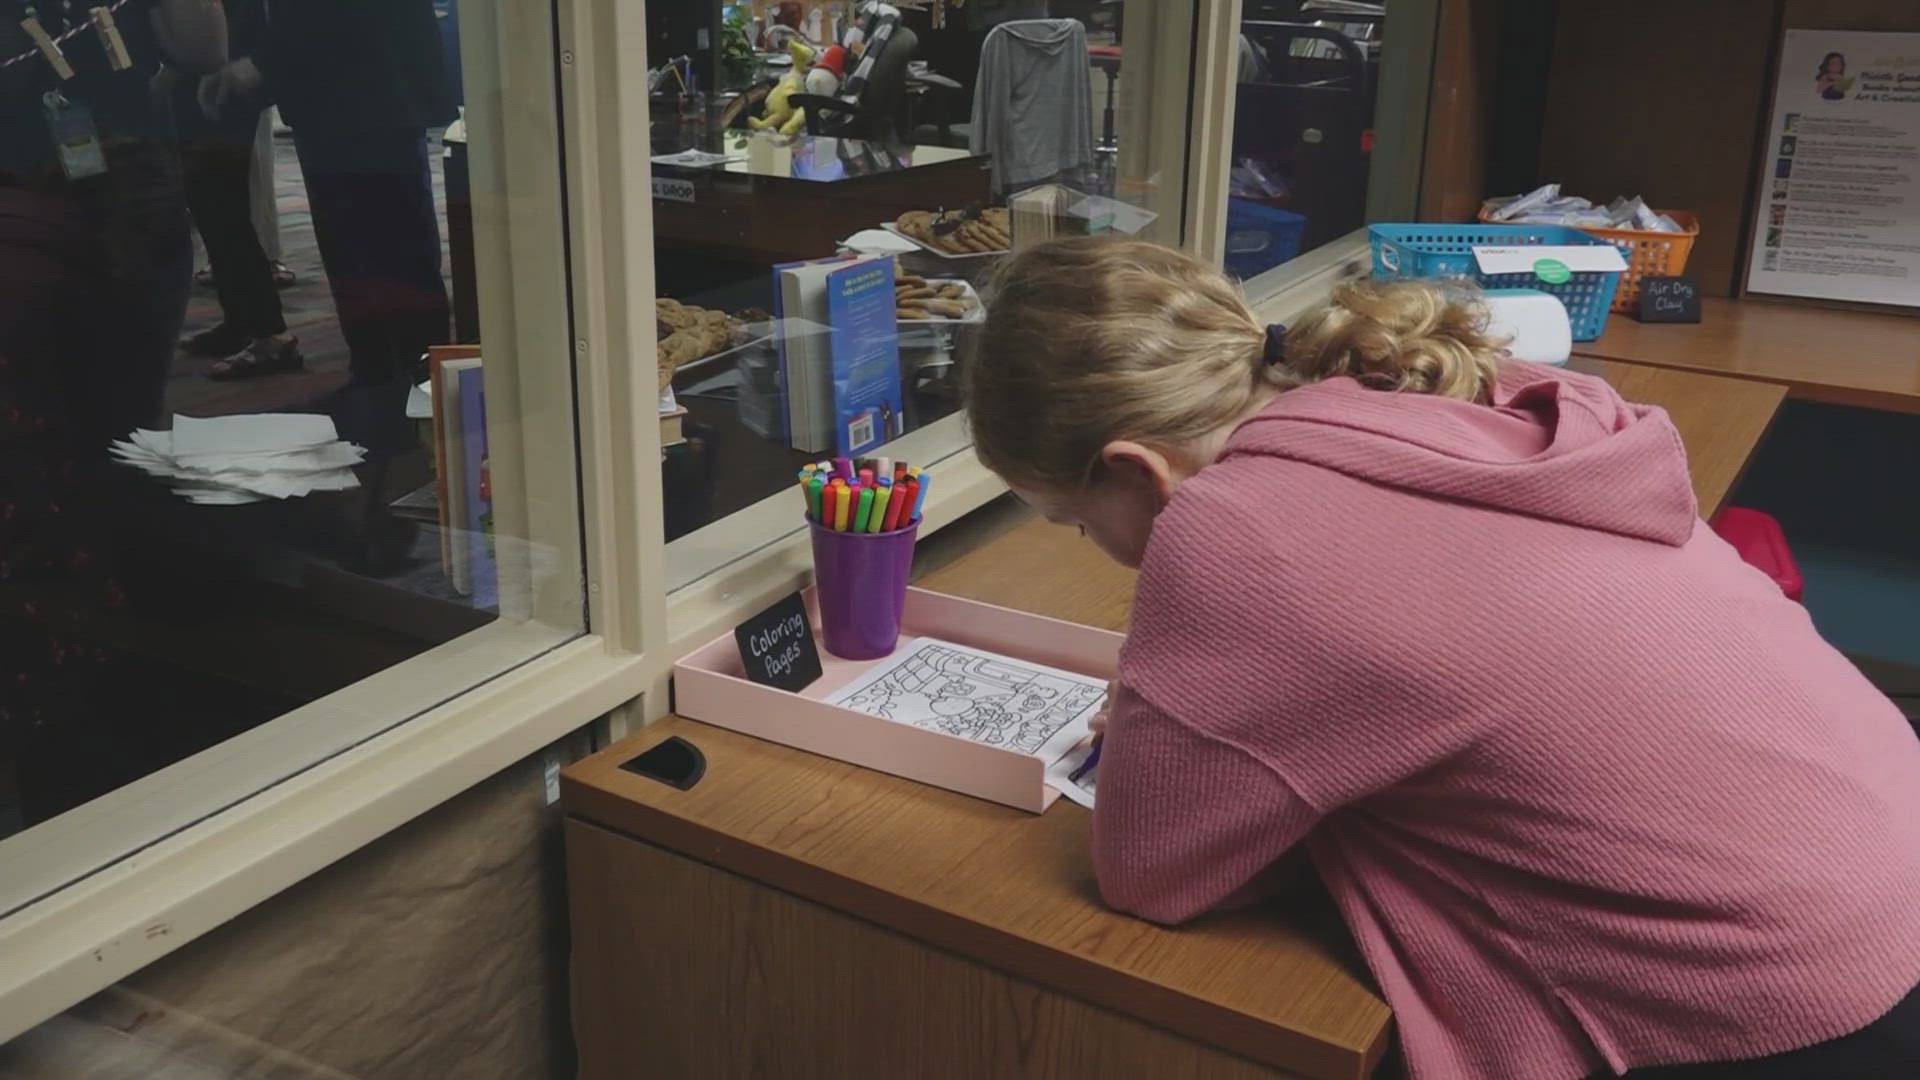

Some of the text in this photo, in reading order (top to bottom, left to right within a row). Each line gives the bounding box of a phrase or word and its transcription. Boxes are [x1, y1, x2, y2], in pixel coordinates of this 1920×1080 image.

[663, 183, 692, 198] DROP
[1649, 281, 1693, 298] Air Dry
[1656, 297, 1684, 312] Clay
[750, 613, 804, 657] Coloring
[765, 641, 801, 678] Pages
